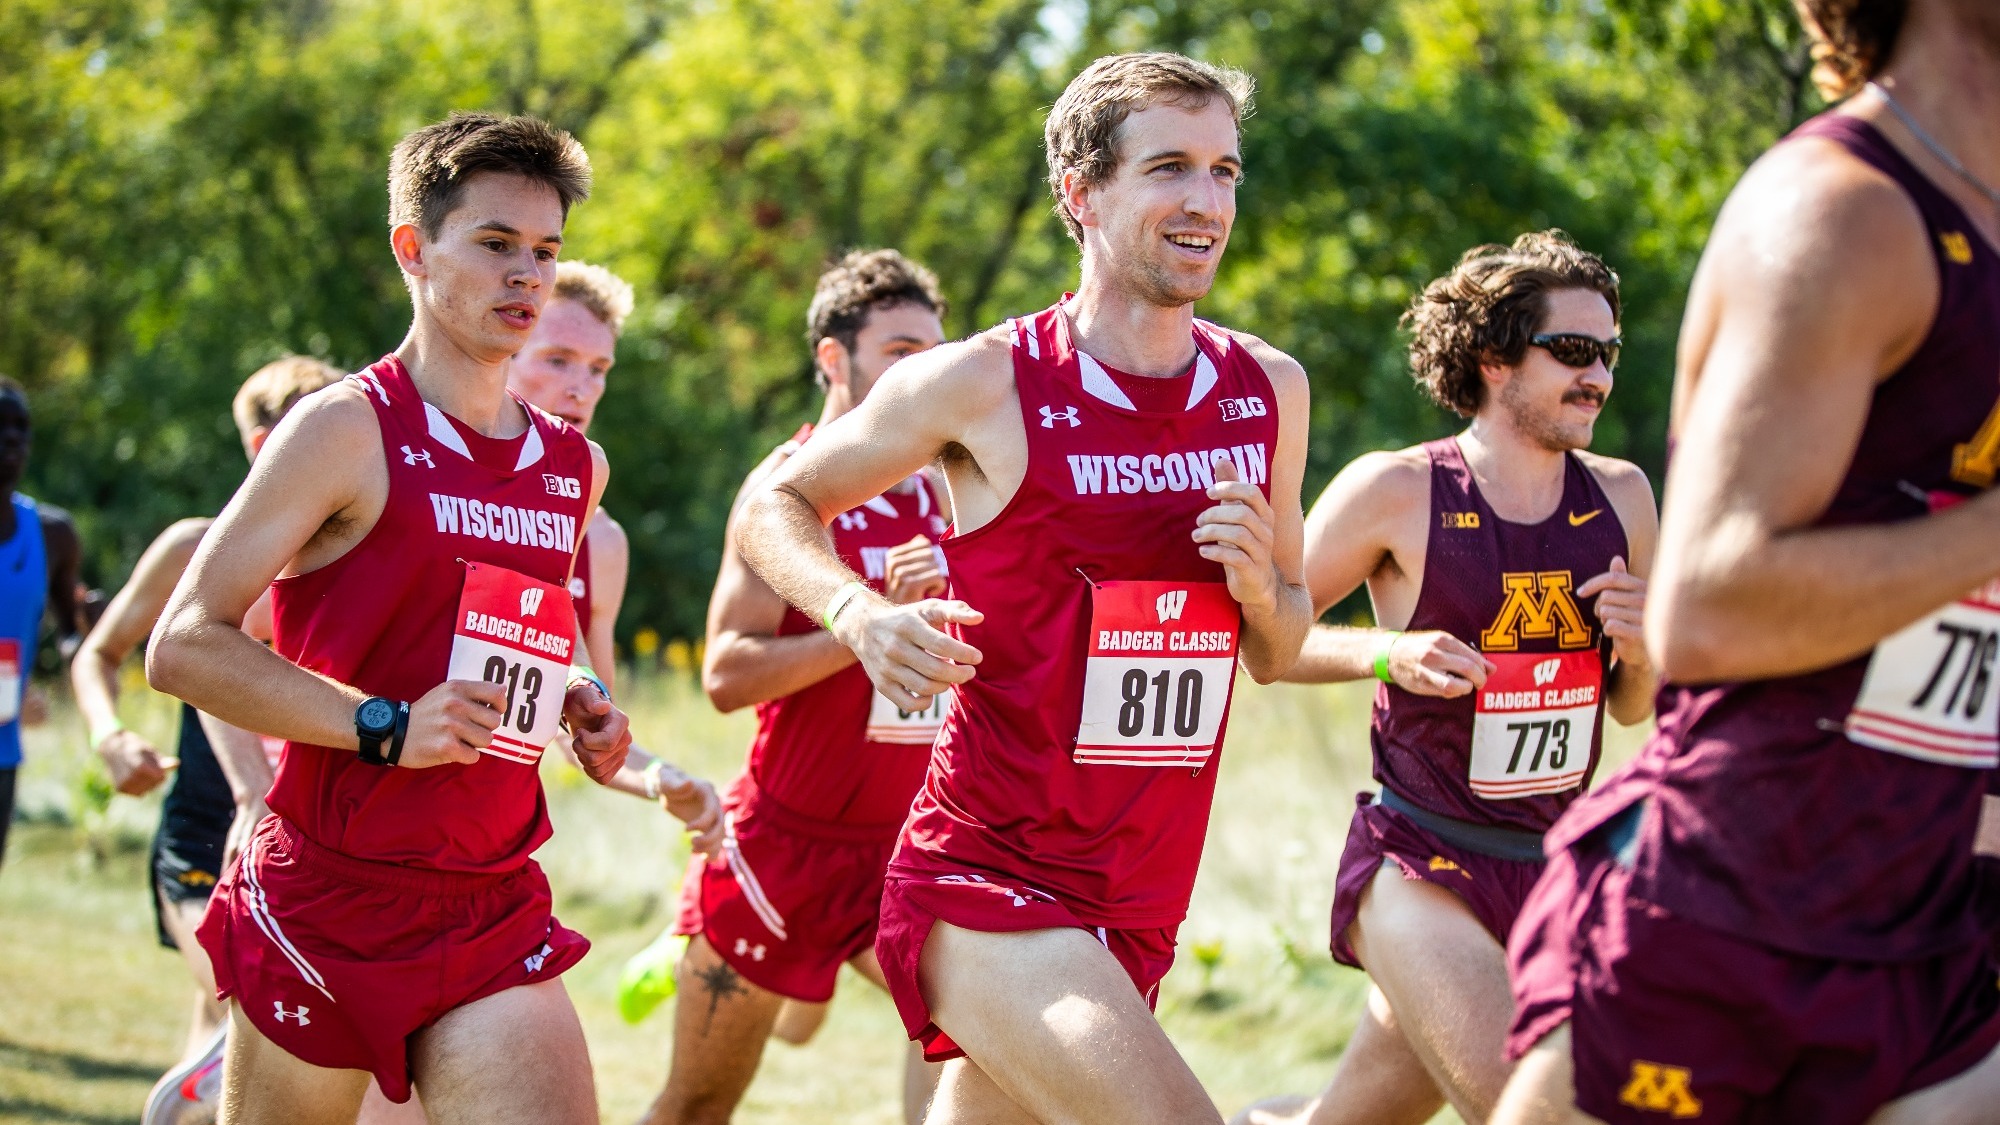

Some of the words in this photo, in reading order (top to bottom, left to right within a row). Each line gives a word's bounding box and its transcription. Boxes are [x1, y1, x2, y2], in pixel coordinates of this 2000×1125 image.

[429, 493, 576, 554] WISCONSIN
[1155, 590, 1188, 624] W
[1481, 570, 1592, 650] M
[465, 610, 523, 643] BADGER
[523, 626, 571, 658] CLASSIC
[1098, 630, 1165, 651] BADGER
[1169, 631, 1232, 651] CLASSIC
[1117, 668, 1204, 738] 810
[1484, 691, 1541, 710] BADGER
[1544, 685, 1595, 707] CLASSIC
[1505, 718, 1571, 774] 773
